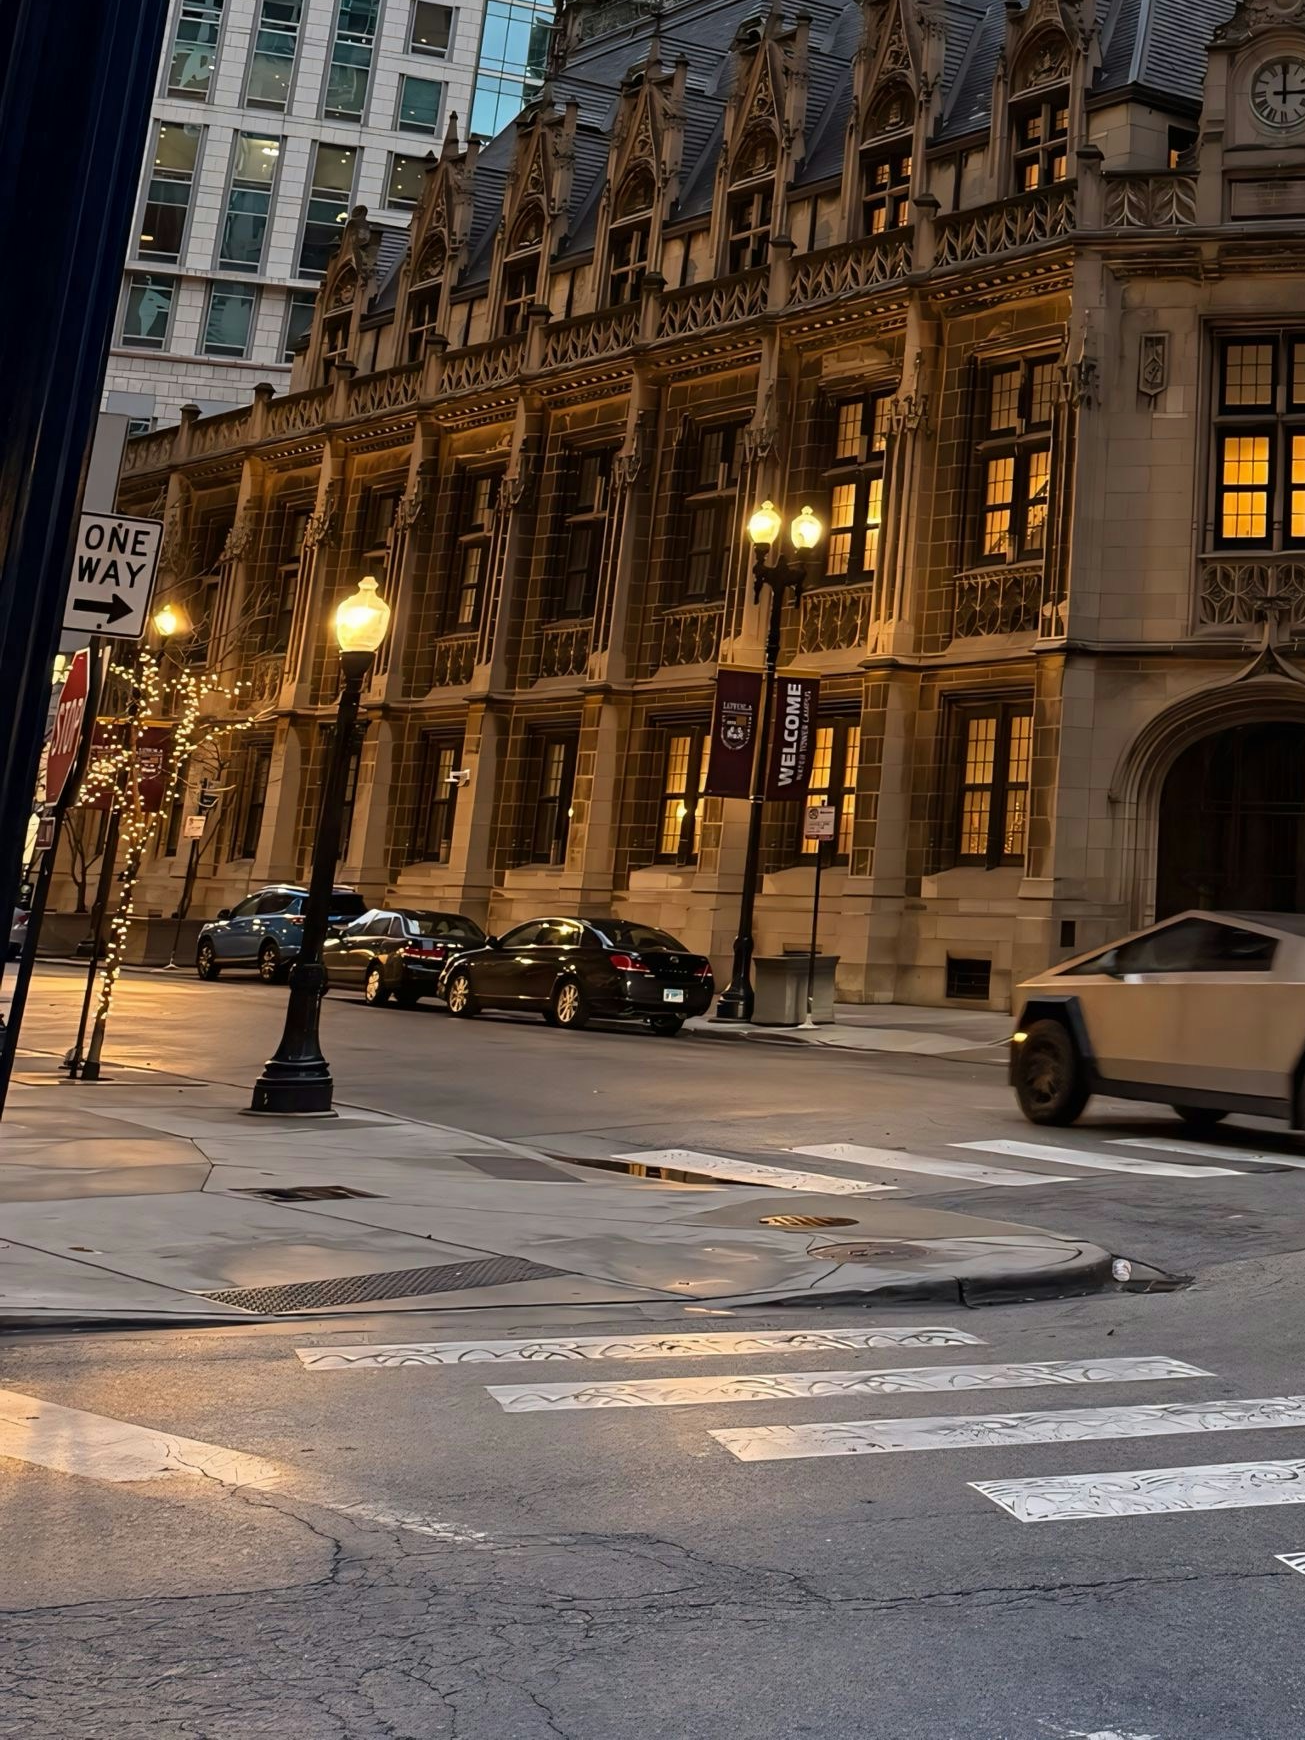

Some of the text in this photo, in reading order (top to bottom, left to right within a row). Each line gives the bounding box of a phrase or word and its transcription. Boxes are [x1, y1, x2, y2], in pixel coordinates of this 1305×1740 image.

[85, 524, 150, 557] ONE
[78, 555, 146, 588] WAY
[51, 697, 84, 756] STOP
[778, 683, 802, 787] WELCOME
